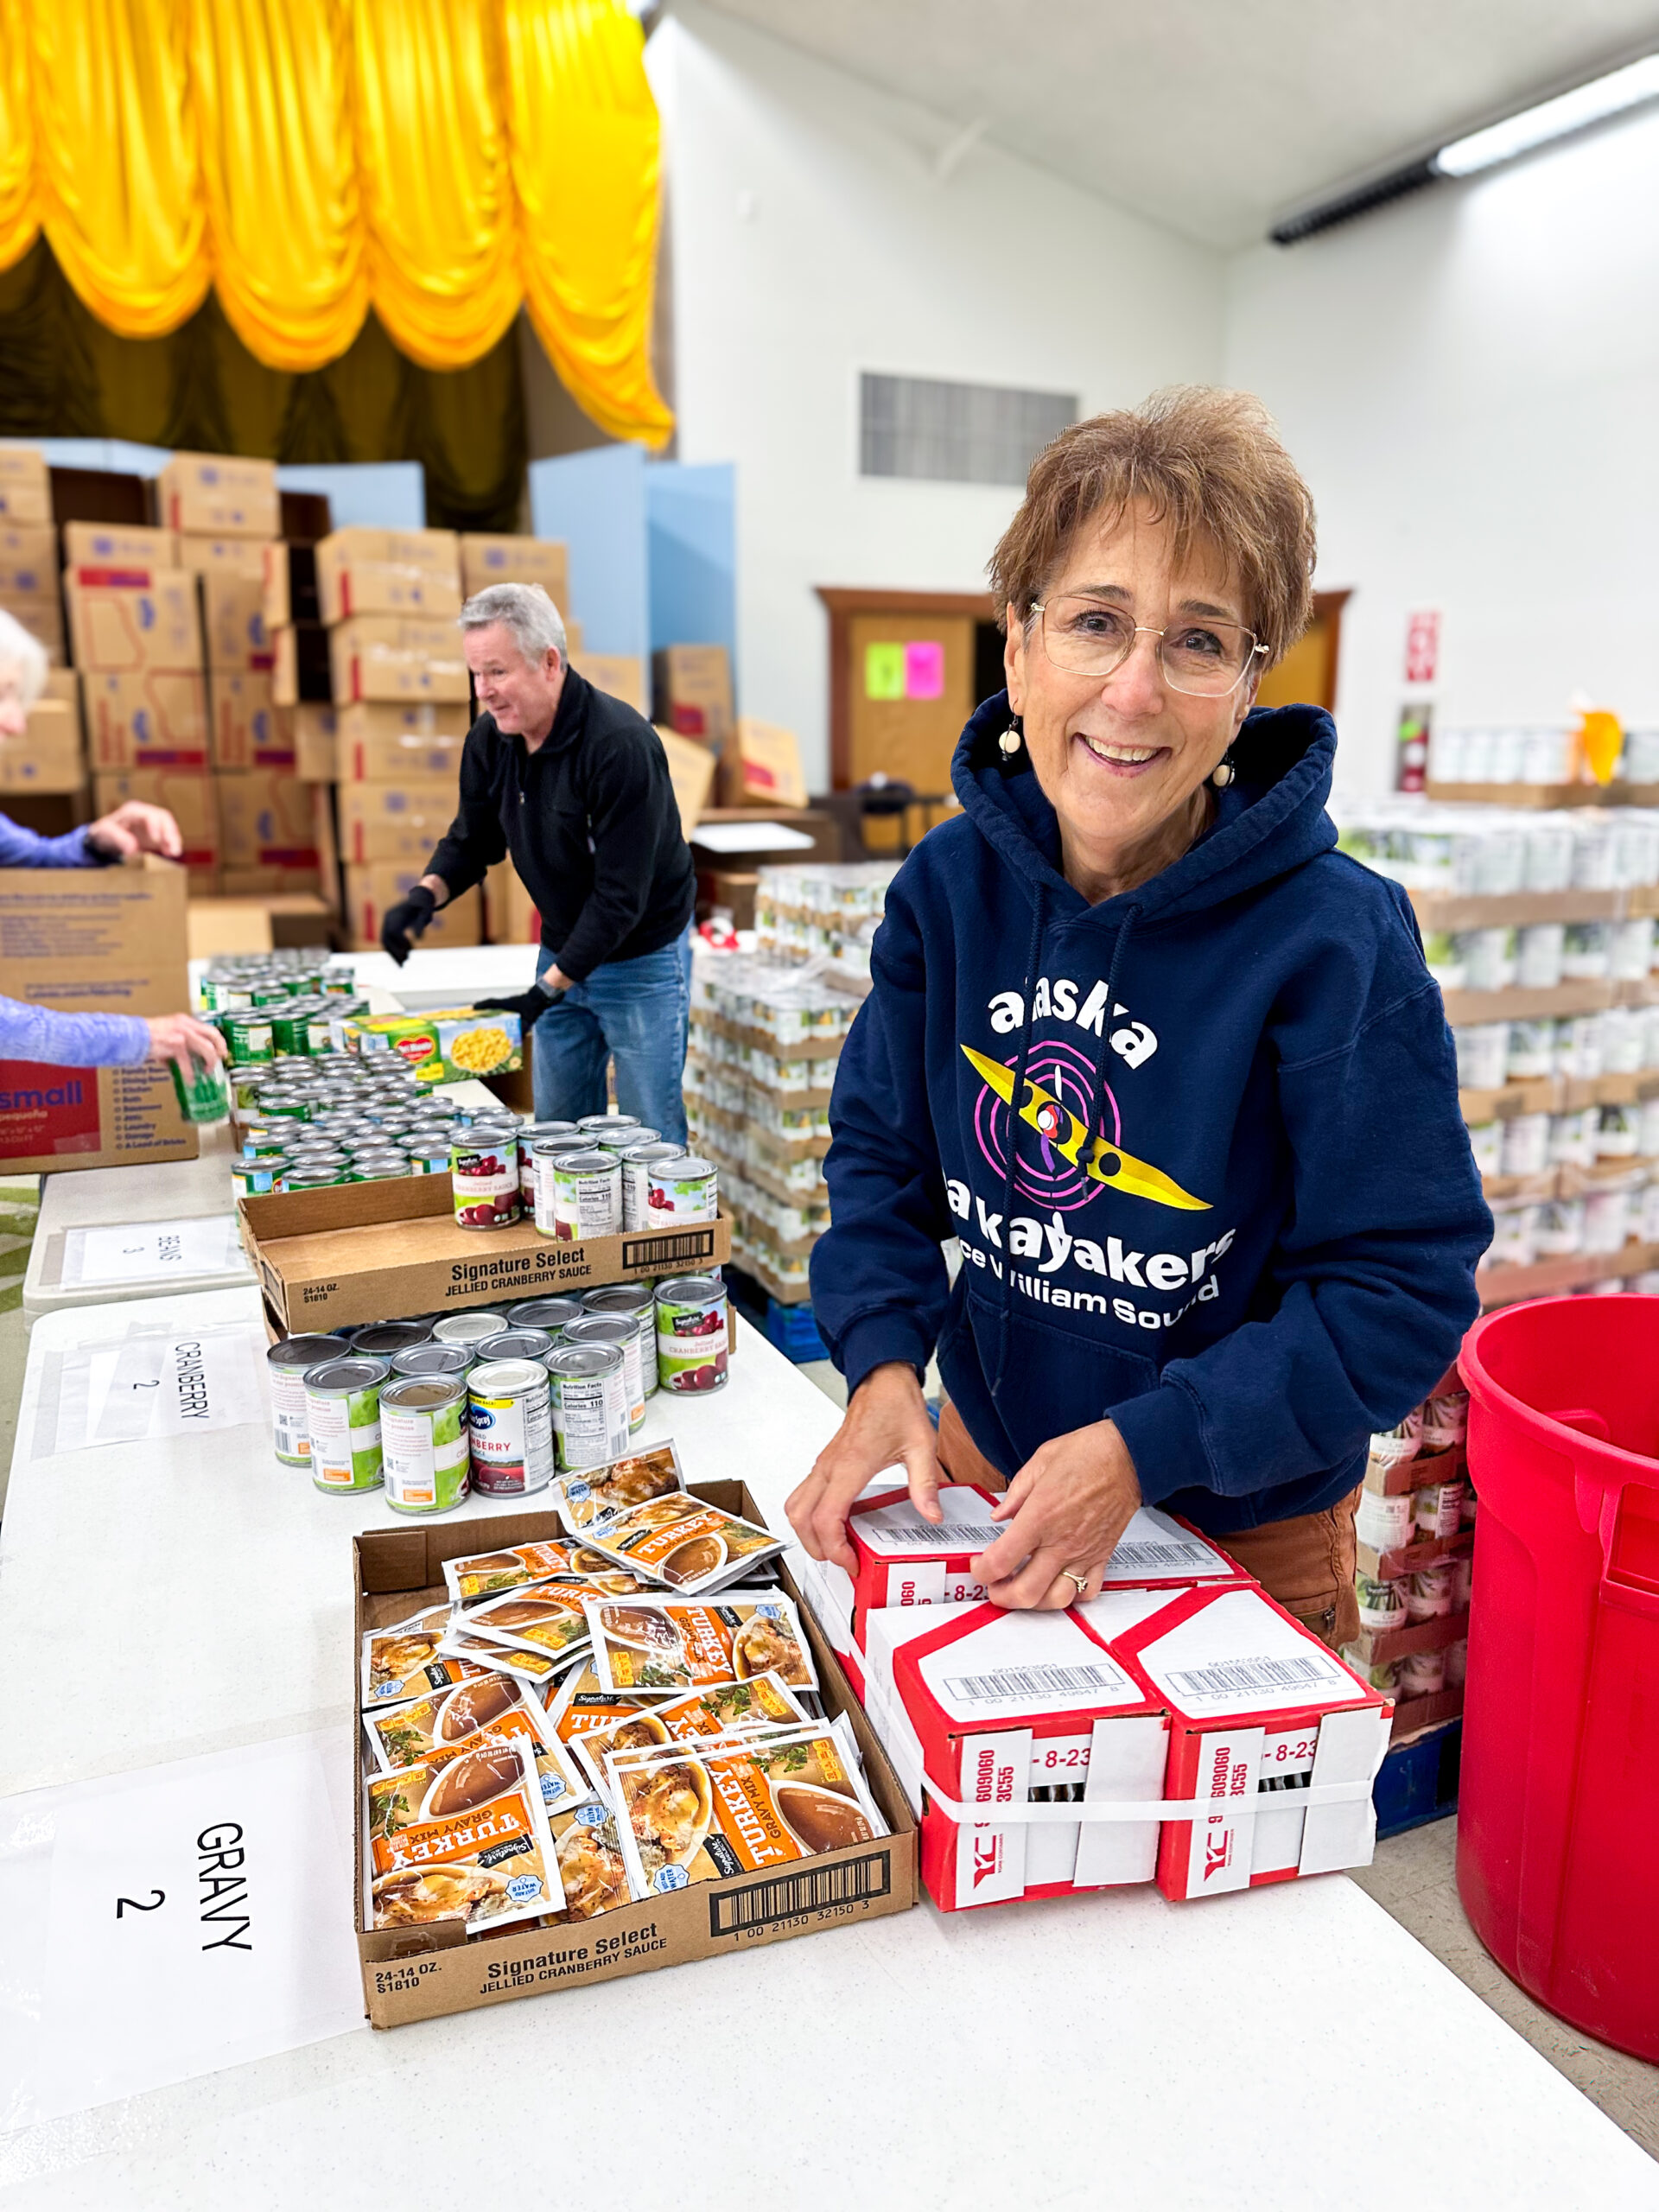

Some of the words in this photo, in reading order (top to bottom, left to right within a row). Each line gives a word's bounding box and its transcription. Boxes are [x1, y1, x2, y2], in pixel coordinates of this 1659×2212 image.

[987, 976, 1158, 1070] aaska
[0, 1080, 82, 1109] small
[975, 1196, 1236, 1291] kayakers
[451, 1257, 531, 1281] Signature
[536, 1247, 585, 1268] Select
[303, 1284, 326, 1295] 24-14
[327, 1282, 340, 1293] OZ.
[445, 1280, 488, 1297] JELLIED
[491, 1269, 556, 1291] CRANBERRY
[558, 1264, 592, 1279] SAUCE
[133, 1379, 160, 1390] 2
[175, 1341, 210, 1419] CRANBERRY
[638, 1513, 714, 1554] TURKEY
[534, 1585, 598, 1601] TURK
[954, 1584, 989, 1601] 8-2
[685, 1605, 734, 1675] TURKEY
[1010, 1693, 1052, 1702] 21130
[1236, 1688, 1274, 1698] 21130
[1045, 1748, 1090, 1768] 8-23
[741, 1776, 761, 1799] MIX
[443, 1808, 493, 1834] GRAVY
[714, 1768, 779, 1866] TURKEY
[754, 1801, 781, 1840] GRAVY
[387, 1812, 520, 1872] TURKEY
[409, 1828, 439, 1845] MIX
[712, 1834, 734, 1875] Signature
[197, 1822, 252, 1951] GRAVY
[512, 1882, 537, 1893] WATER
[669, 1868, 679, 1890] WATER
[116, 1889, 166, 1919] 2
[734, 1932, 739, 1942] 1
[747, 1926, 764, 1938] 00
[772, 1915, 809, 1933] 21130
[817, 1904, 854, 1922] 32150
[861, 1899, 870, 1910] 3
[487, 1946, 588, 1979] Signature
[595, 1922, 658, 1955] Select
[375, 1967, 416, 1984] 24-14
[418, 1961, 442, 1976] OZ.
[480, 1973, 535, 1994] JELLIED
[539, 1951, 620, 1981] CRANBERRY
[624, 1938, 668, 1960] SAUCE
[378, 1977, 420, 1994] S1810
